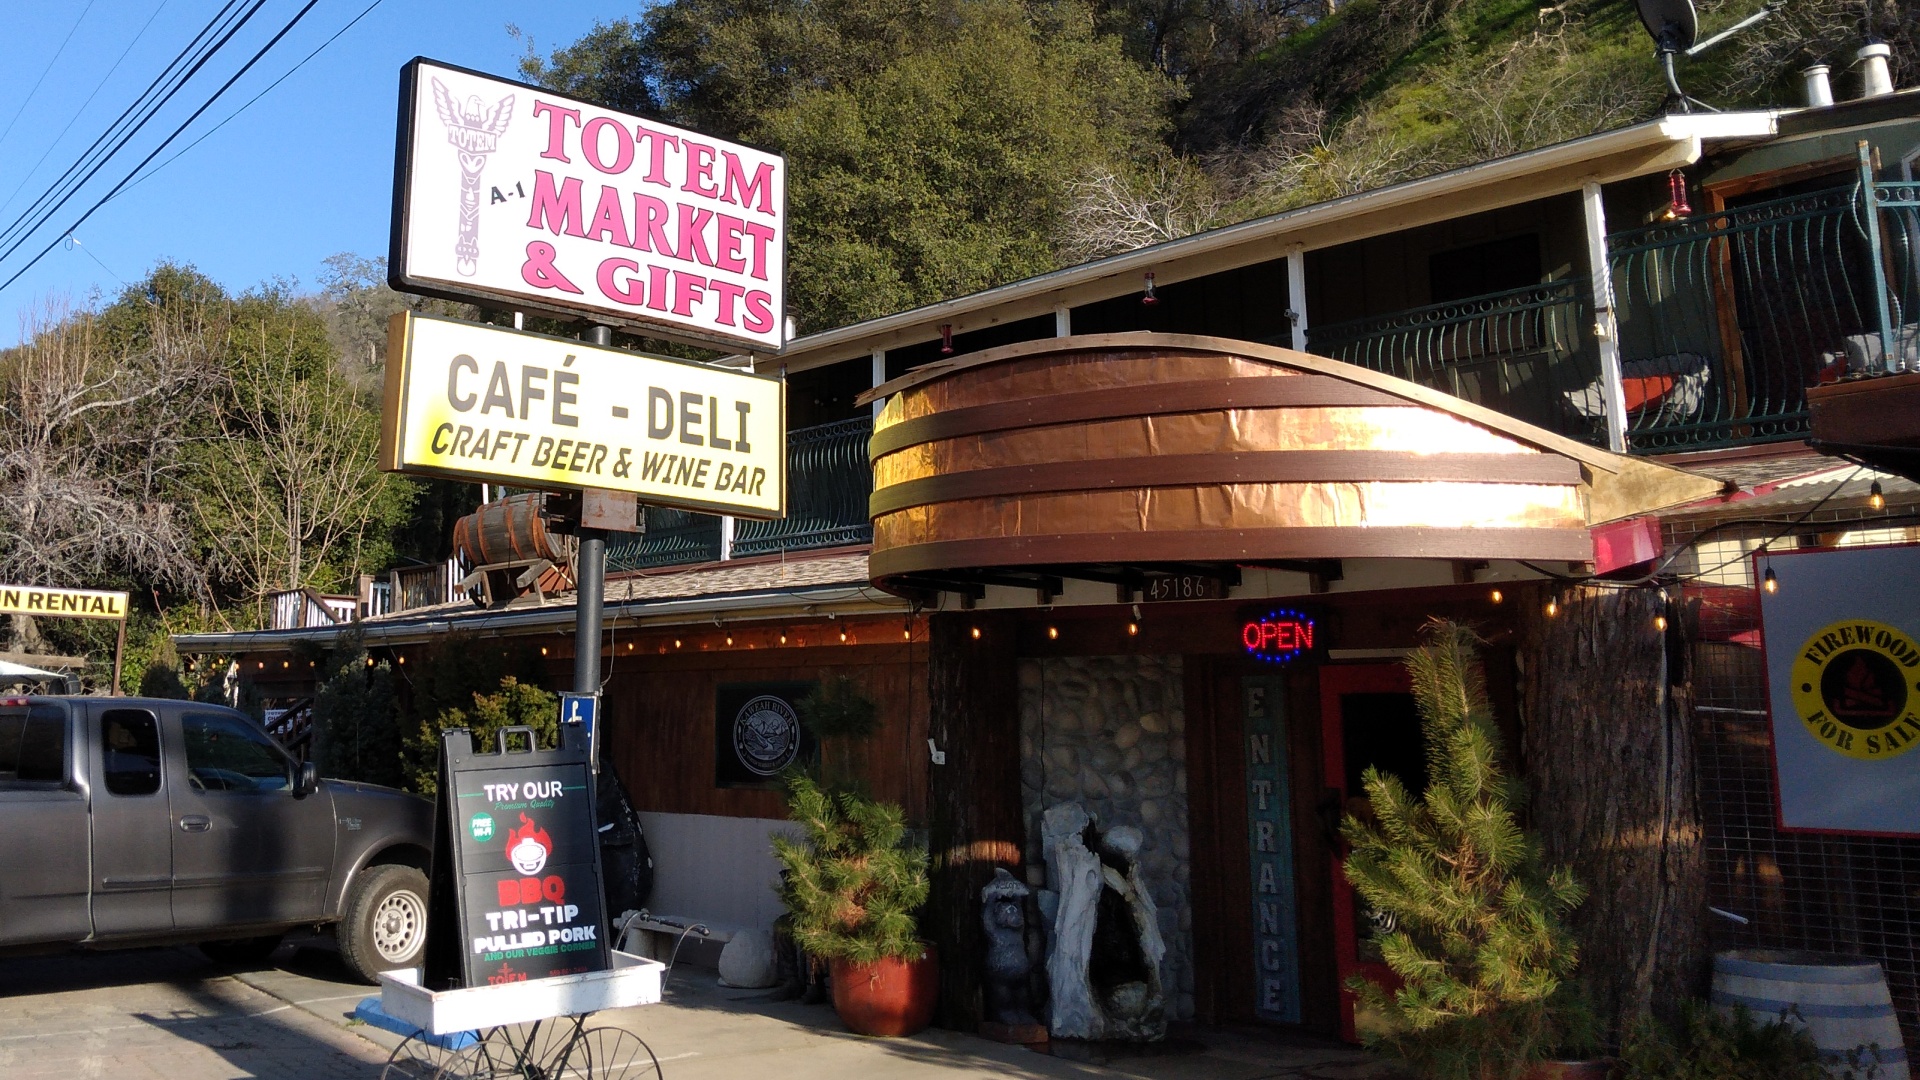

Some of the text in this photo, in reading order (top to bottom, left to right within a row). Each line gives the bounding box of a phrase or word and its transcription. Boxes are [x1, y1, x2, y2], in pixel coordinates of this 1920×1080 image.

[448, 125, 497, 152] TOTEM
[534, 100, 775, 217] TOTEM
[491, 180, 526, 206] A-1
[527, 169, 775, 281] MARKET
[521, 240, 775, 334] & GIFTS
[447, 354, 751, 454] CAFÉ - DELI
[431, 422, 766, 497] CRAFT BEER & WINE BAR
[1150, 575, 1204, 600] 45186
[0, 590, 120, 614] N RENTAL
[1242, 622, 1313, 649] OPEN
[1804, 625, 1920, 668] FIREWOOD
[740, 700, 794, 727] KAWEAH RIVER
[1807, 710, 1855, 751] FOR
[483, 781, 563, 802] TRY OUR
[494, 799, 555, 811] Premium Quality
[472, 818, 492, 828] FREE
[1248, 687, 1281, 1013] ENTRANCE
[497, 875, 565, 907] BBQ
[485, 904, 579, 931] TRI-TIP
[473, 925, 597, 954] PULLED PORK
[484, 941, 596, 961] AND OUR VEGGIE CORNER
